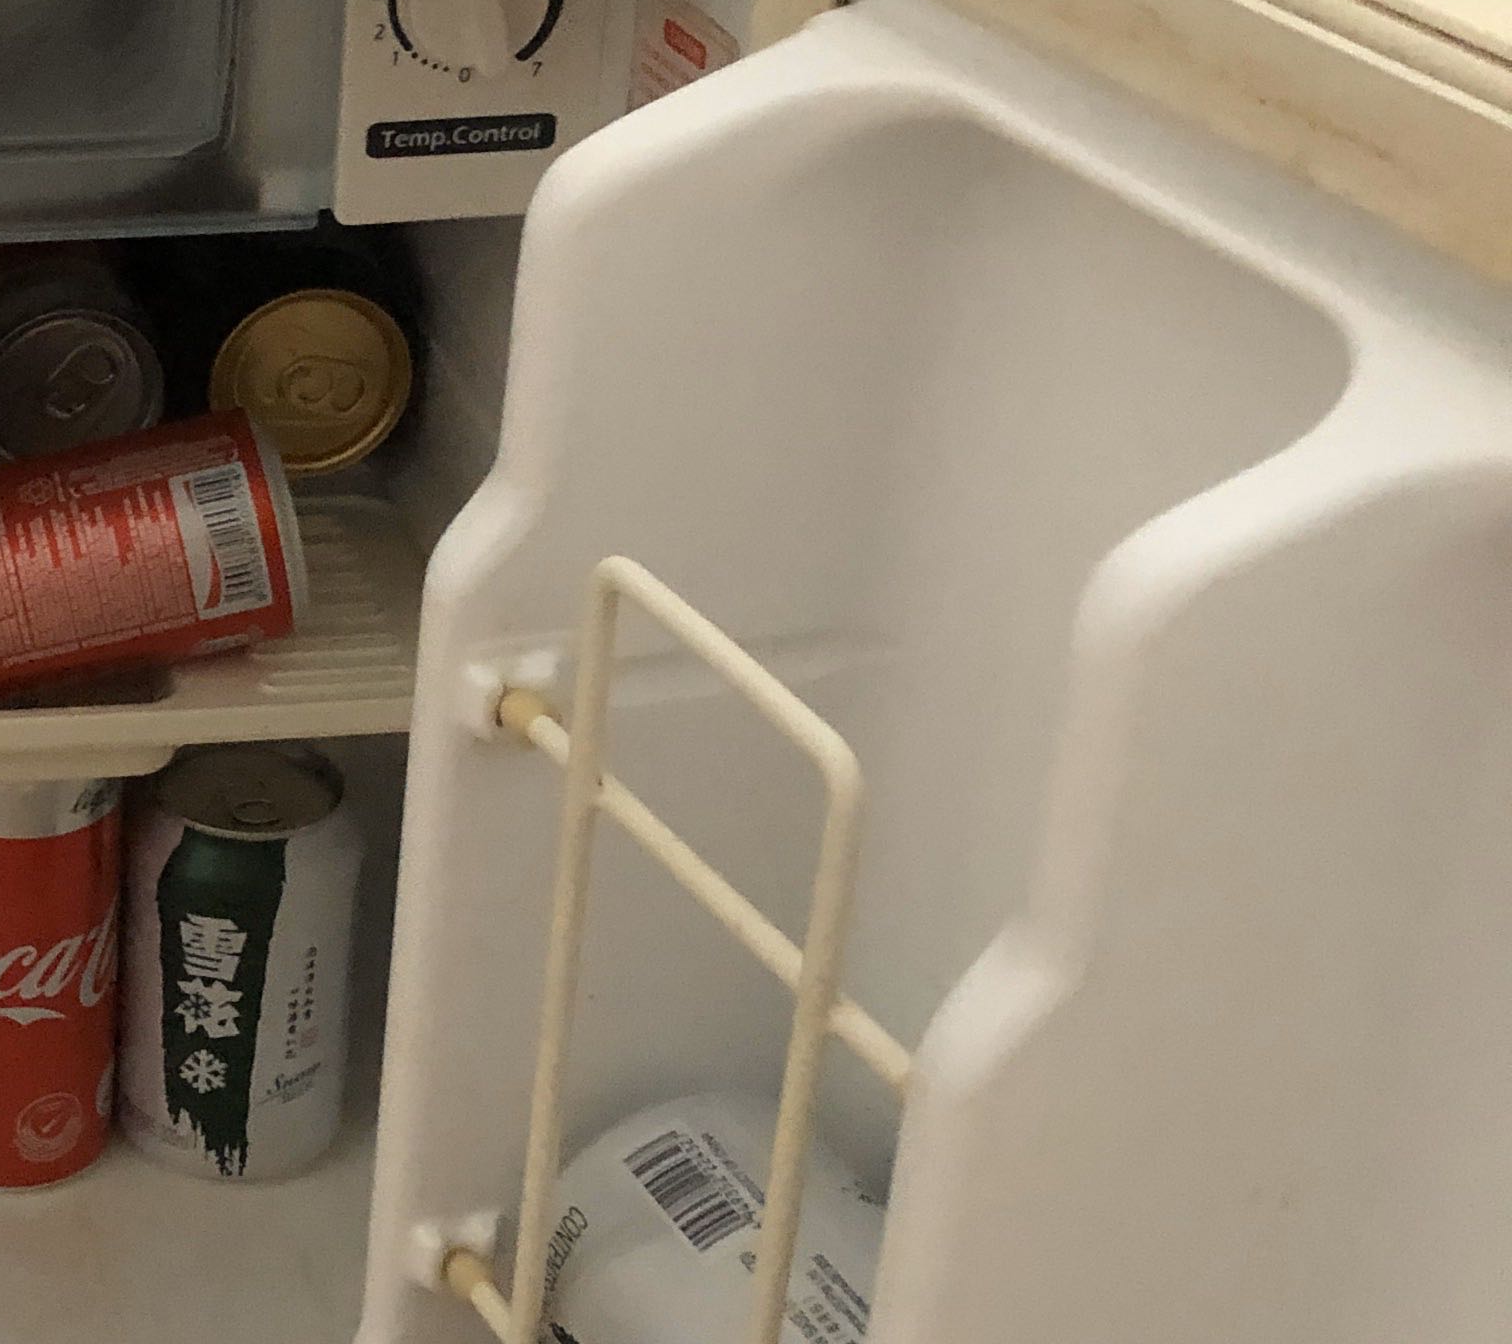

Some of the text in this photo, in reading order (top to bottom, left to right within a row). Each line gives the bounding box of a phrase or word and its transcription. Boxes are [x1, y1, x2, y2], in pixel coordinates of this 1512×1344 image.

[372, 23, 385, 41] 2
[390, 50, 400, 67] 1
[457, 66, 472, 83] 0
[531, 61, 544, 78] 7
[380, 121, 543, 151] Temp.Control
